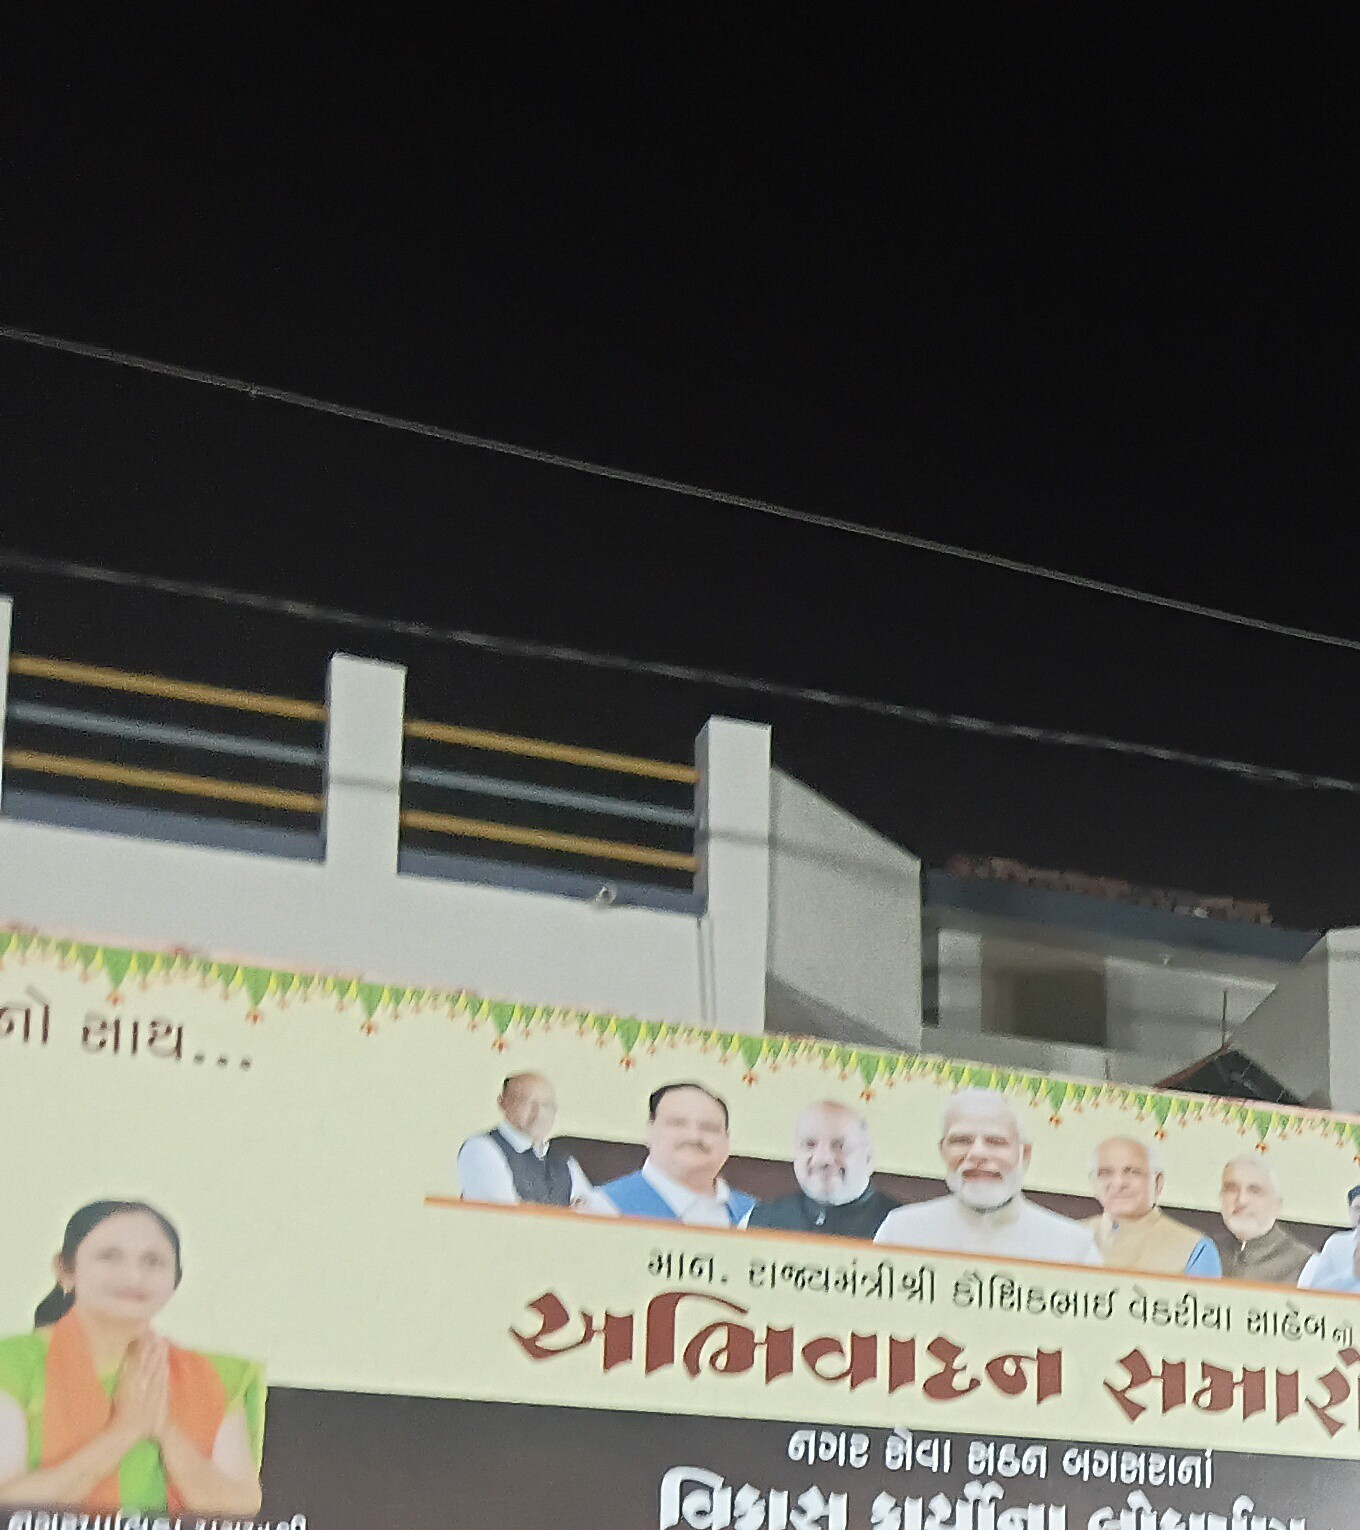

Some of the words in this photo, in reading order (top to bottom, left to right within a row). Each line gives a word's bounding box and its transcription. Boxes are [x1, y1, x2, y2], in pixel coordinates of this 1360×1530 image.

[648, 1248, 728, 1284] માન.
[748, 1257, 936, 1305] રાજ્યમંત્રીશ્રી
[1245, 1300, 1327, 1343] સાહેબ
[510, 1290, 1063, 1405] અભિવાદન
[787, 1428, 871, 1469] નગર
[885, 1424, 952, 1473] સેવા
[968, 1438, 1049, 1479] સદન
